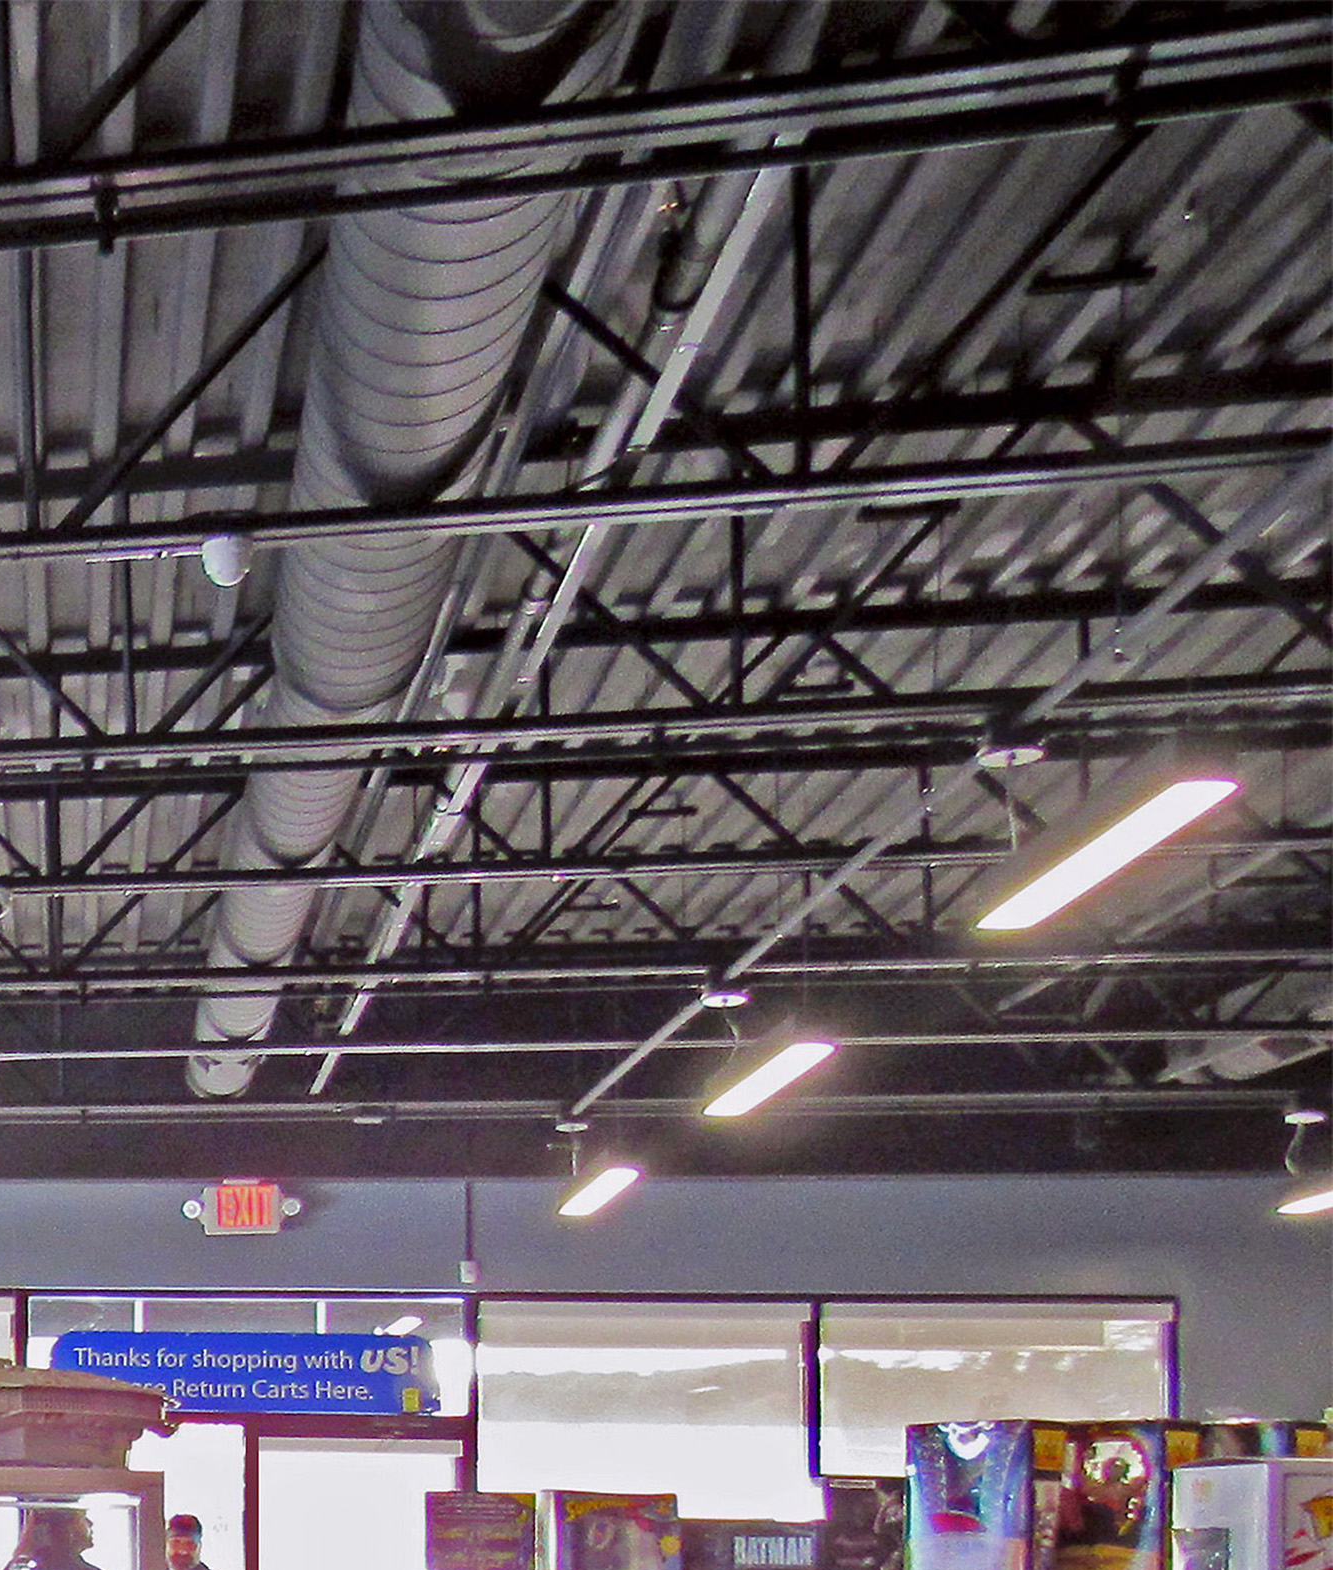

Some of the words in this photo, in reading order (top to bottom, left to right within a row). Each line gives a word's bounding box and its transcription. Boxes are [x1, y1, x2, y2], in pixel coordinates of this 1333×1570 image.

[219, 1185, 274, 1227] EXIT
[73, 1347, 151, 1368] Thanks
[156, 1346, 188, 1368] for
[192, 1348, 297, 1374] shopping
[303, 1347, 354, 1370] with
[359, 1346, 420, 1376] US!
[172, 1380, 246, 1400] Return
[251, 1380, 310, 1401] Carts
[315, 1381, 374, 1402] Here.
[733, 1535, 813, 1565] BATMAN
